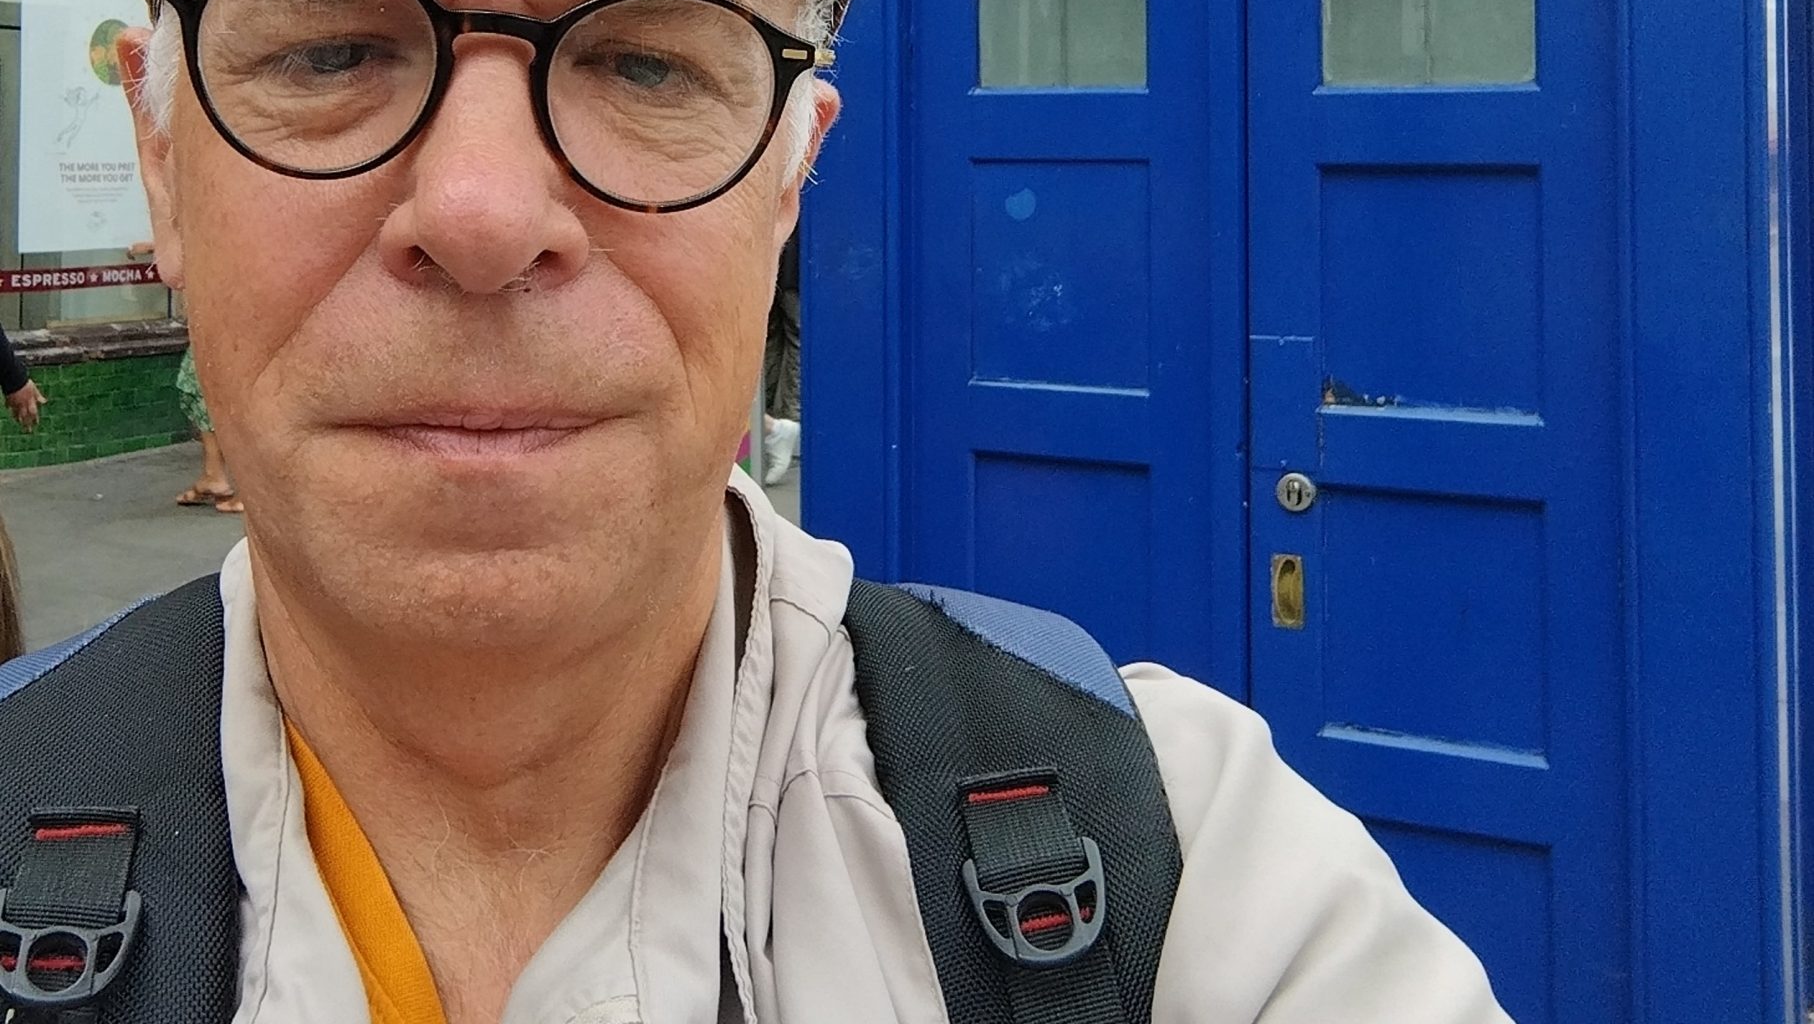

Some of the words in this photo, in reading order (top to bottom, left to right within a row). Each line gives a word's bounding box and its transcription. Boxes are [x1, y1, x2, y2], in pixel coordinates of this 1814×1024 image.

[59, 162, 76, 172] THE
[77, 162, 99, 172] MORE
[101, 162, 117, 172] YOU
[61, 174, 77, 183] THE
[78, 173, 101, 183] MORE
[103, 173, 119, 183] YOU
[119, 173, 134, 182] GET
[11, 271, 85, 287] ESPRESSO
[102, 268, 142, 283] MOCHA
